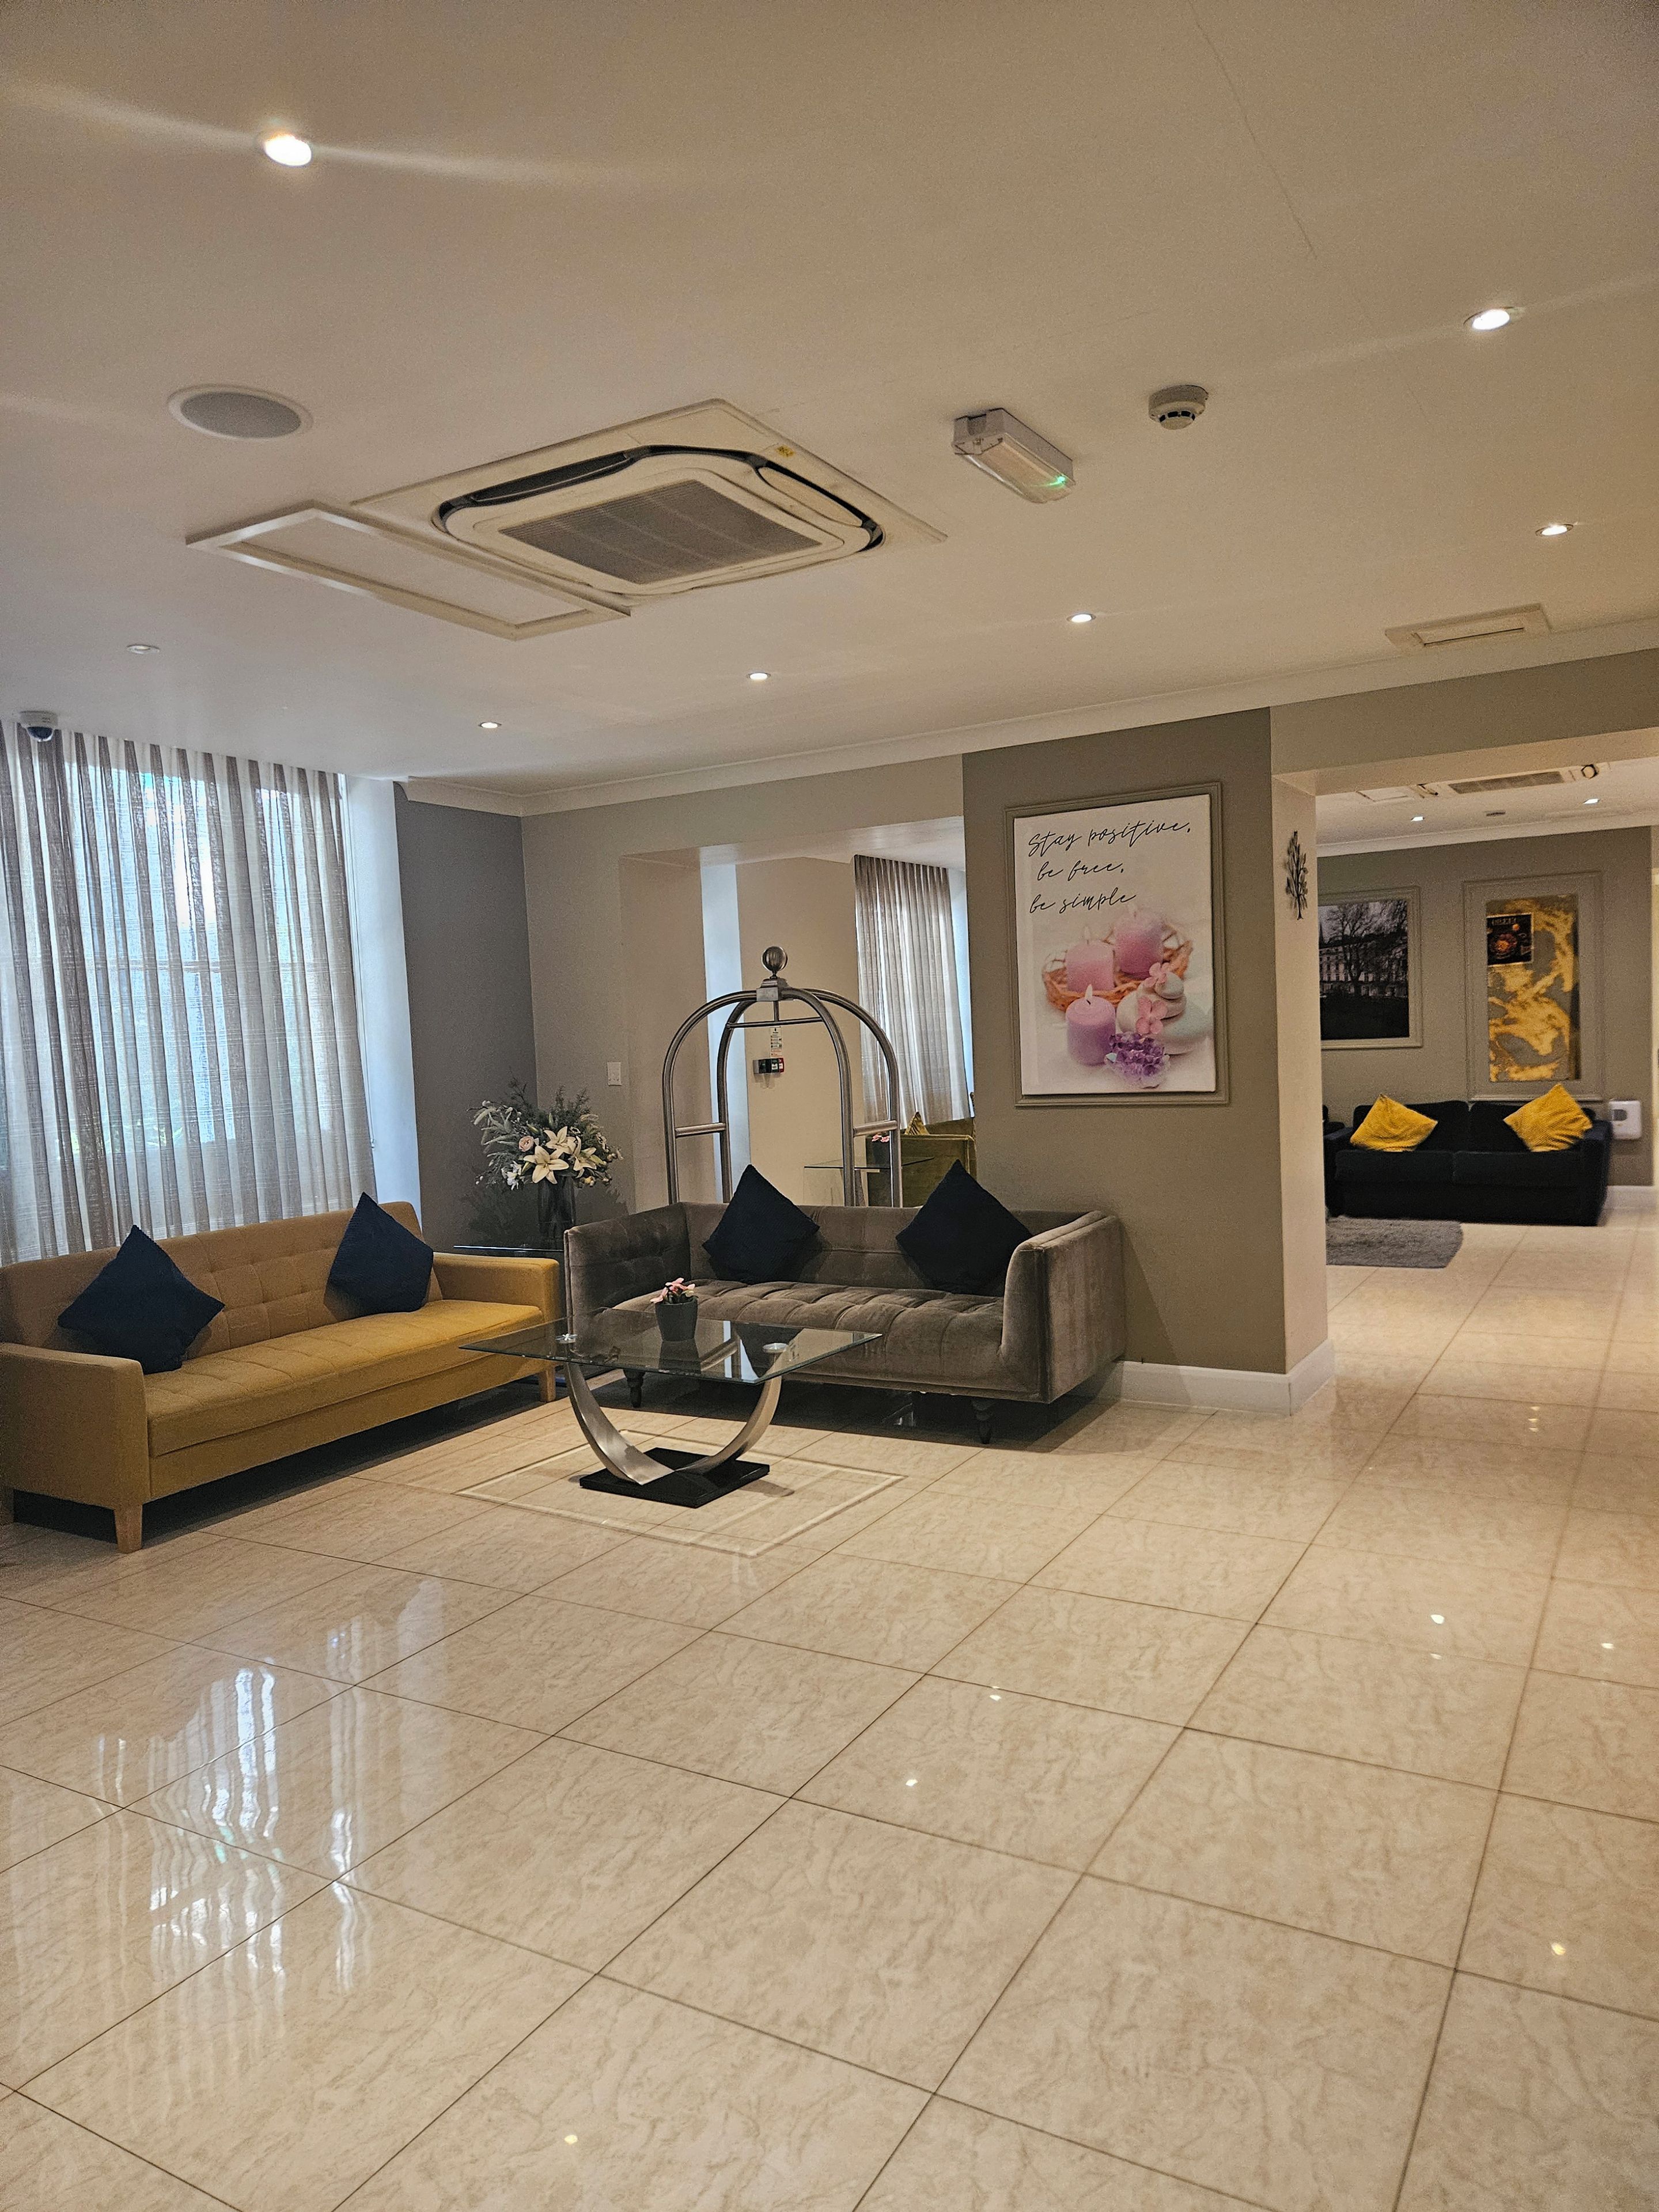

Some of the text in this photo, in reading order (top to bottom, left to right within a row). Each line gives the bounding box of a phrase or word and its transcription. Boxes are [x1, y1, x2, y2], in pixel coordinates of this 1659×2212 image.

[1028, 831, 1082, 857] Stay
[1037, 861, 1064, 881] be
[1029, 887, 1137, 914] be simple
